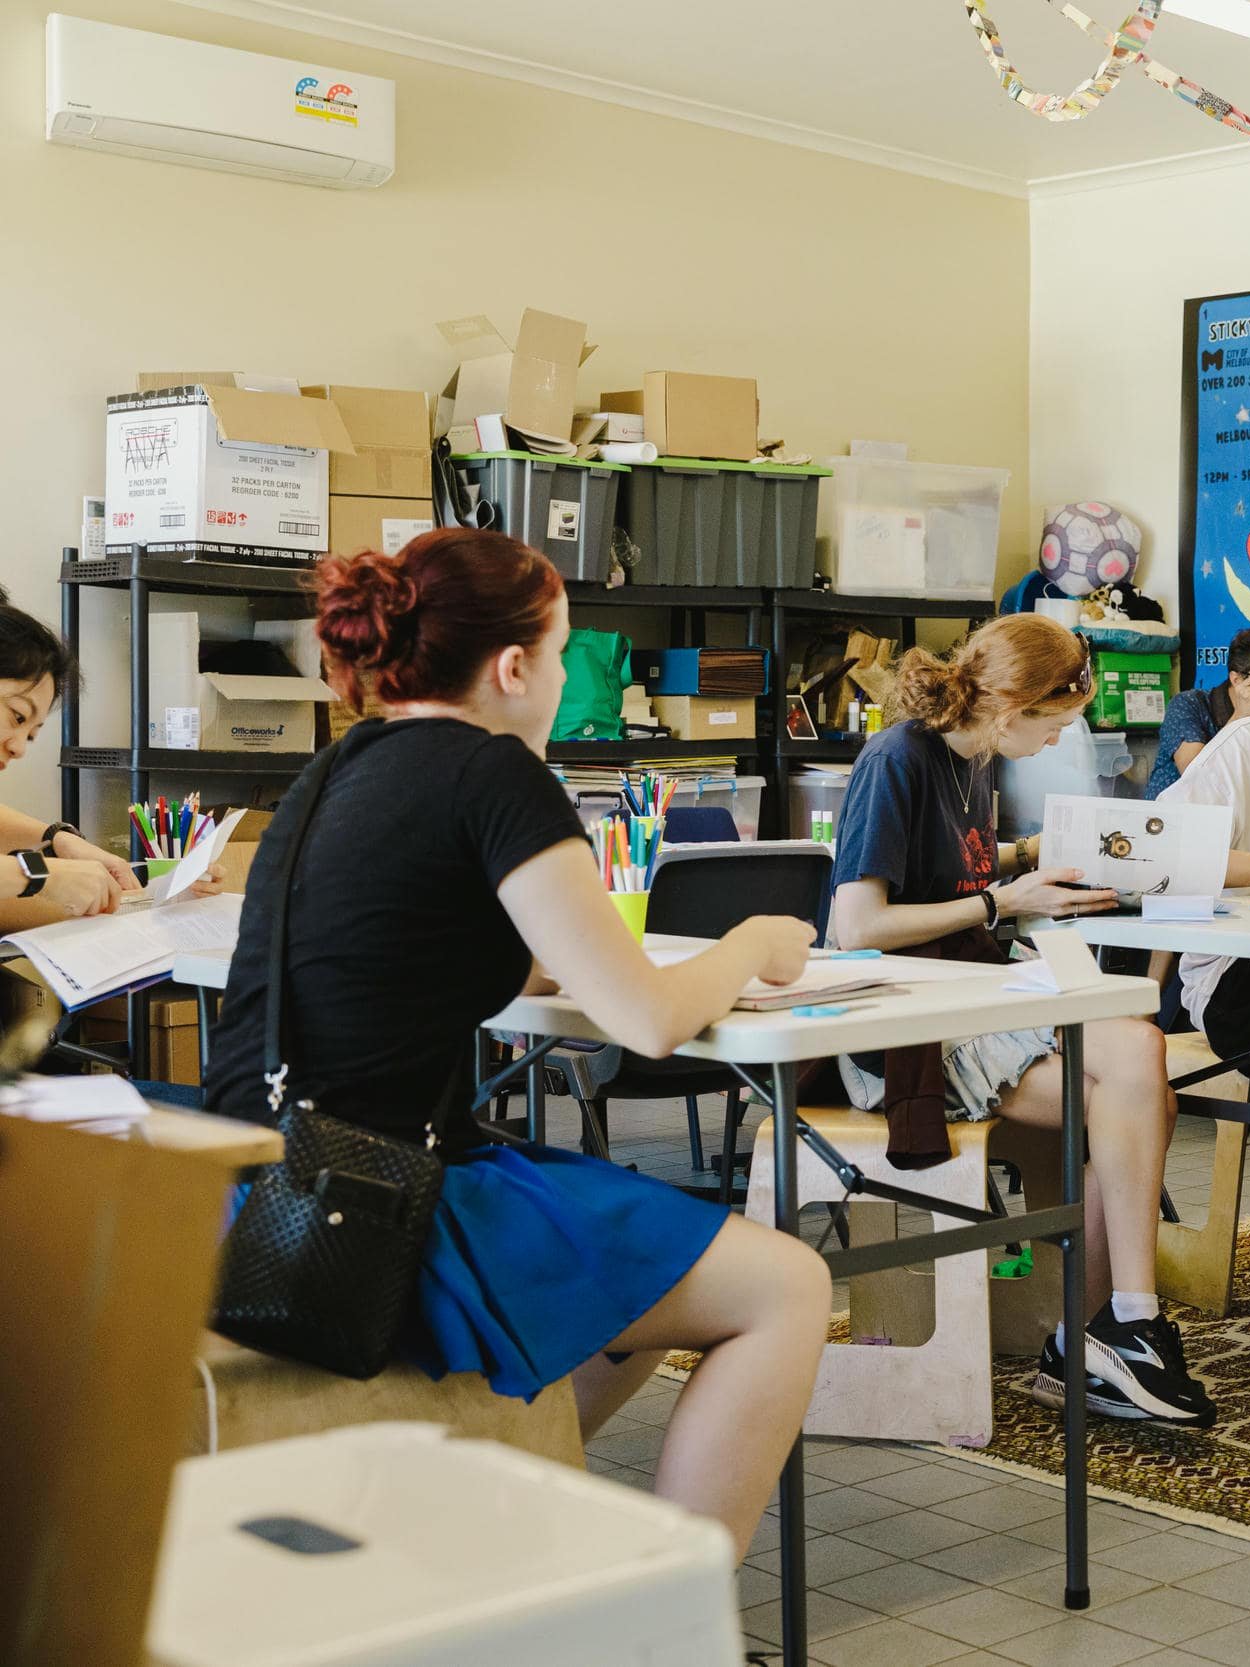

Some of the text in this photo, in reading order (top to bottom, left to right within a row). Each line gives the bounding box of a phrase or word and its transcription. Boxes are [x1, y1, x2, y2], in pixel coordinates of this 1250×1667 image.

[1202, 377, 1224, 391] OVER
[1227, 375, 1245, 387] 200
[1204, 471, 1229, 483] 12PM
